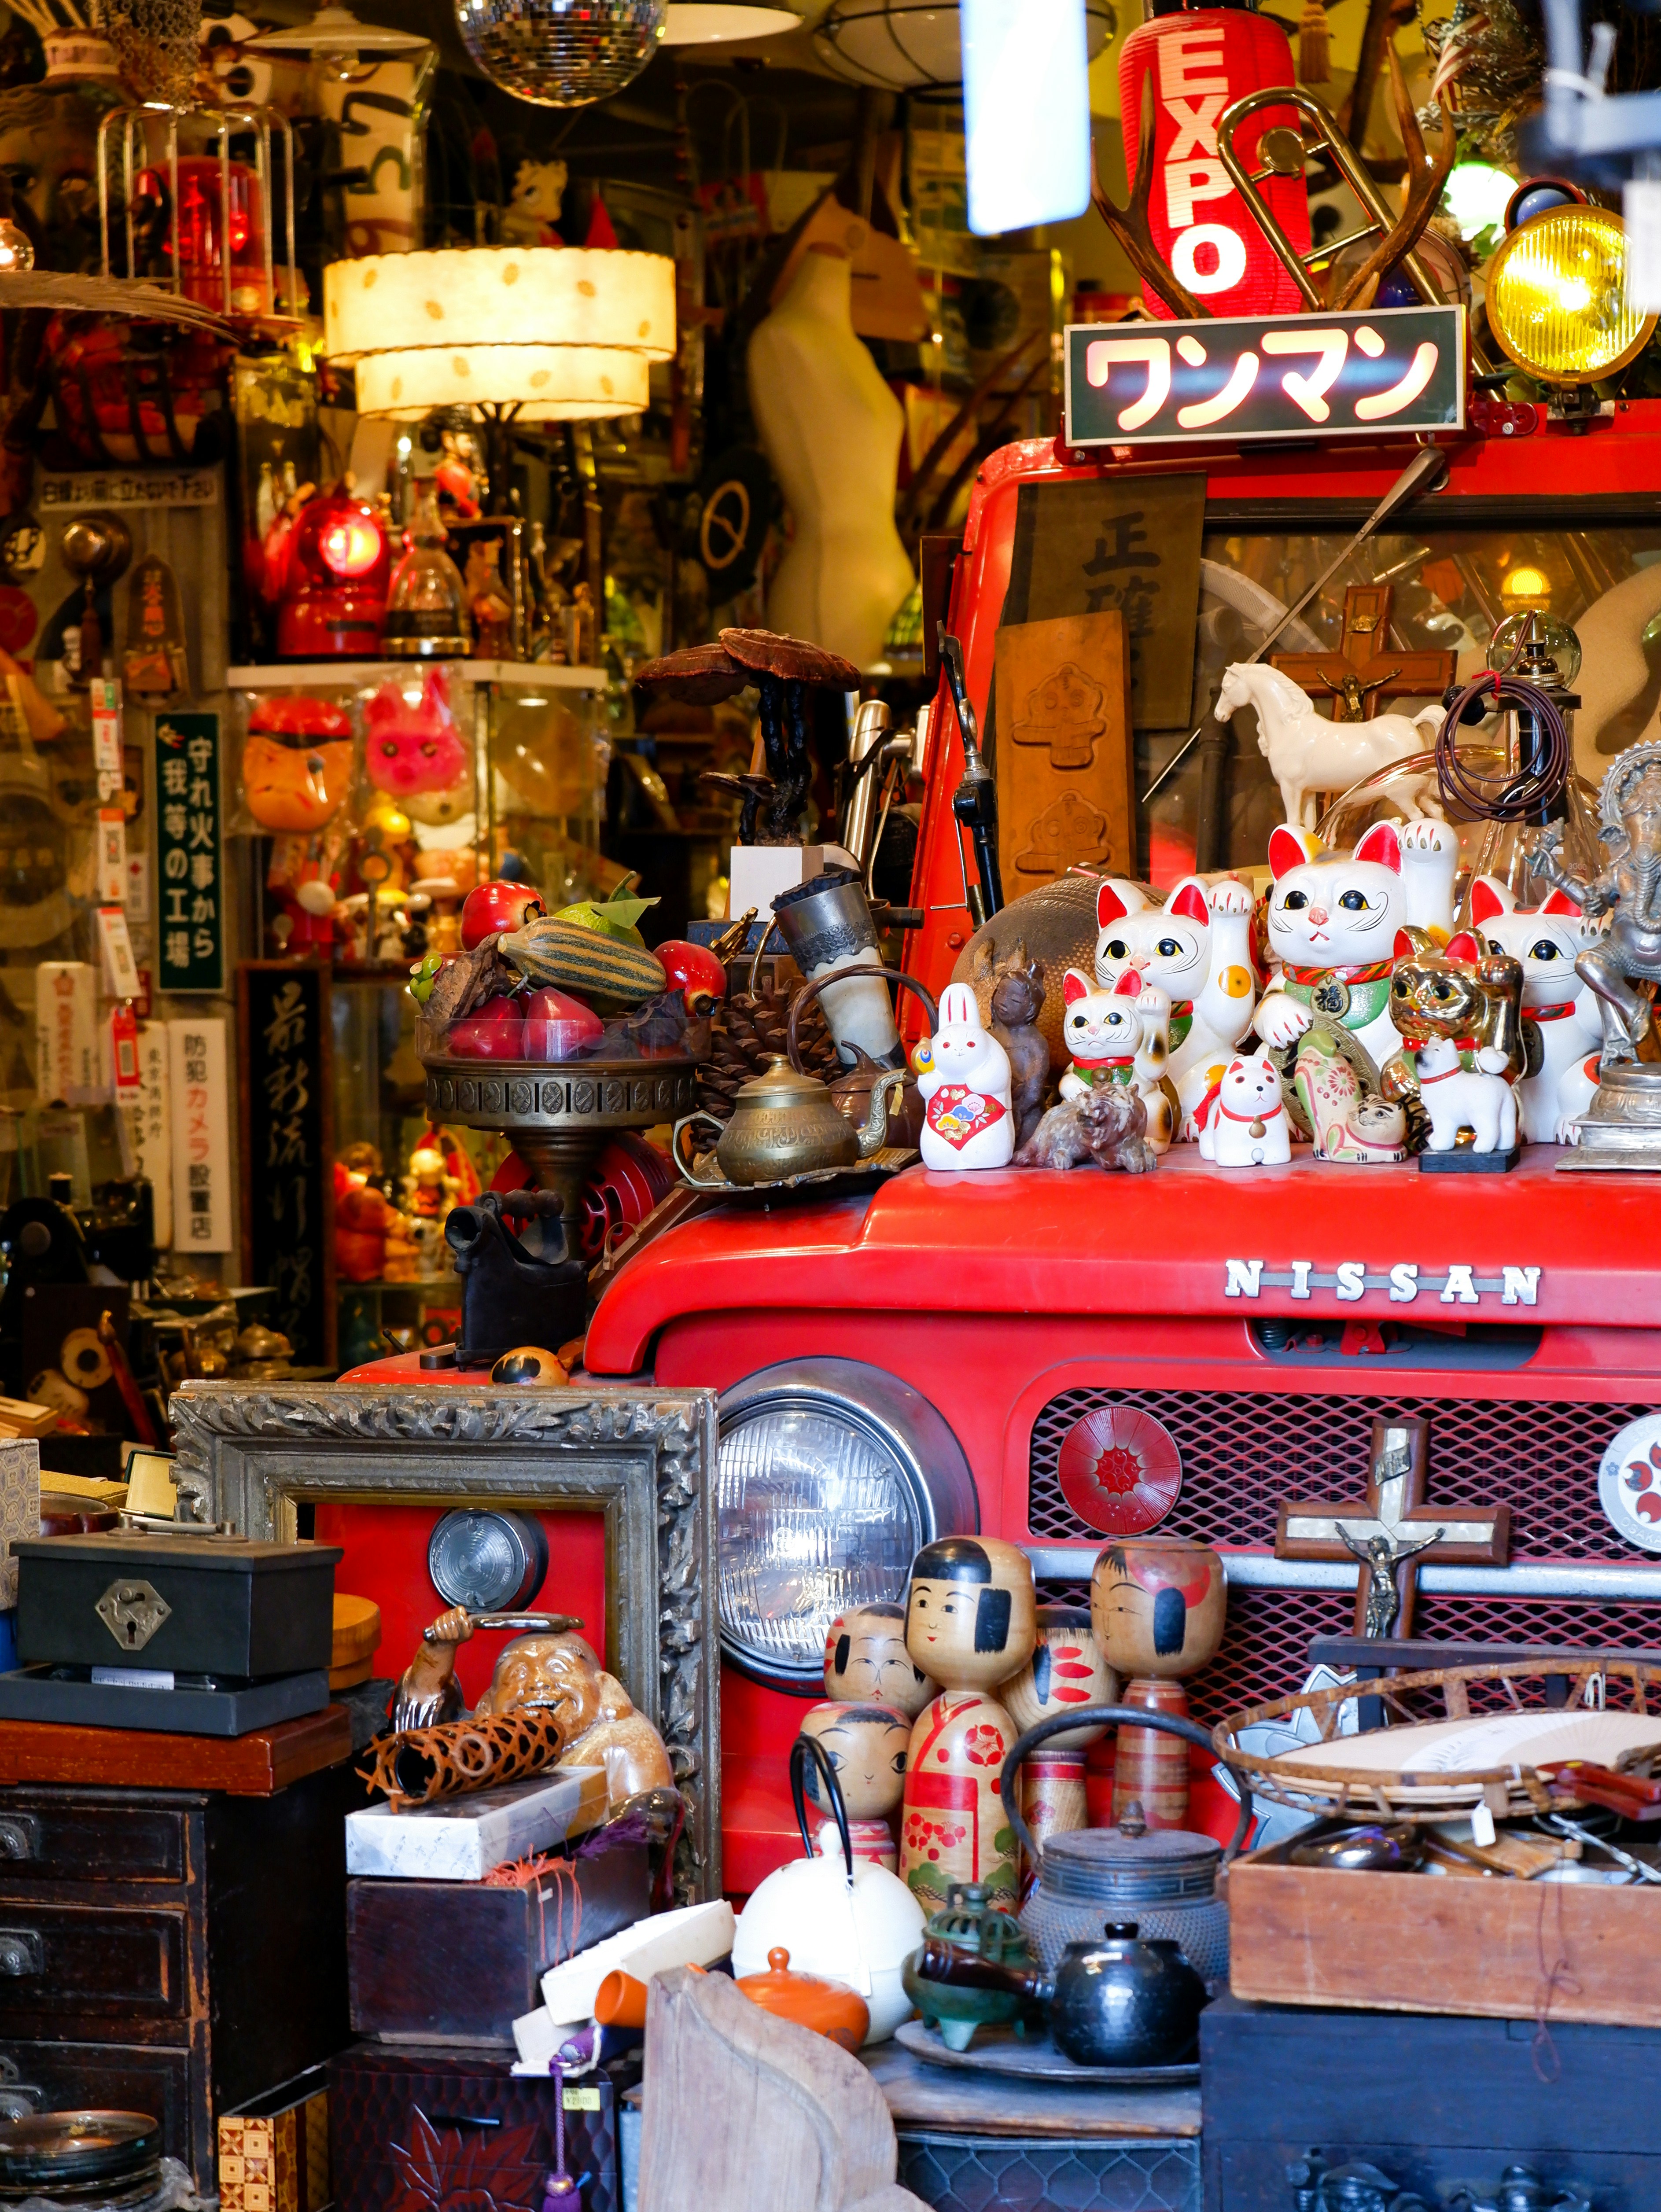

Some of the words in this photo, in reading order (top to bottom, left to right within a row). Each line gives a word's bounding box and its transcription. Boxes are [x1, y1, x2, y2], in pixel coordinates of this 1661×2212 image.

[1158, 28, 1246, 294] EXPO
[1086, 326, 1438, 431] ワンマン
[1082, 511, 1161, 690] 正確
[162, 758, 190, 968] 我等の工場
[188, 736, 215, 959] 守れ火事から
[1315, 985, 1343, 1012] 福
[184, 1034, 212, 1240] 防犯カメラ設置店
[1225, 1259, 1541, 1305] NISSAN
